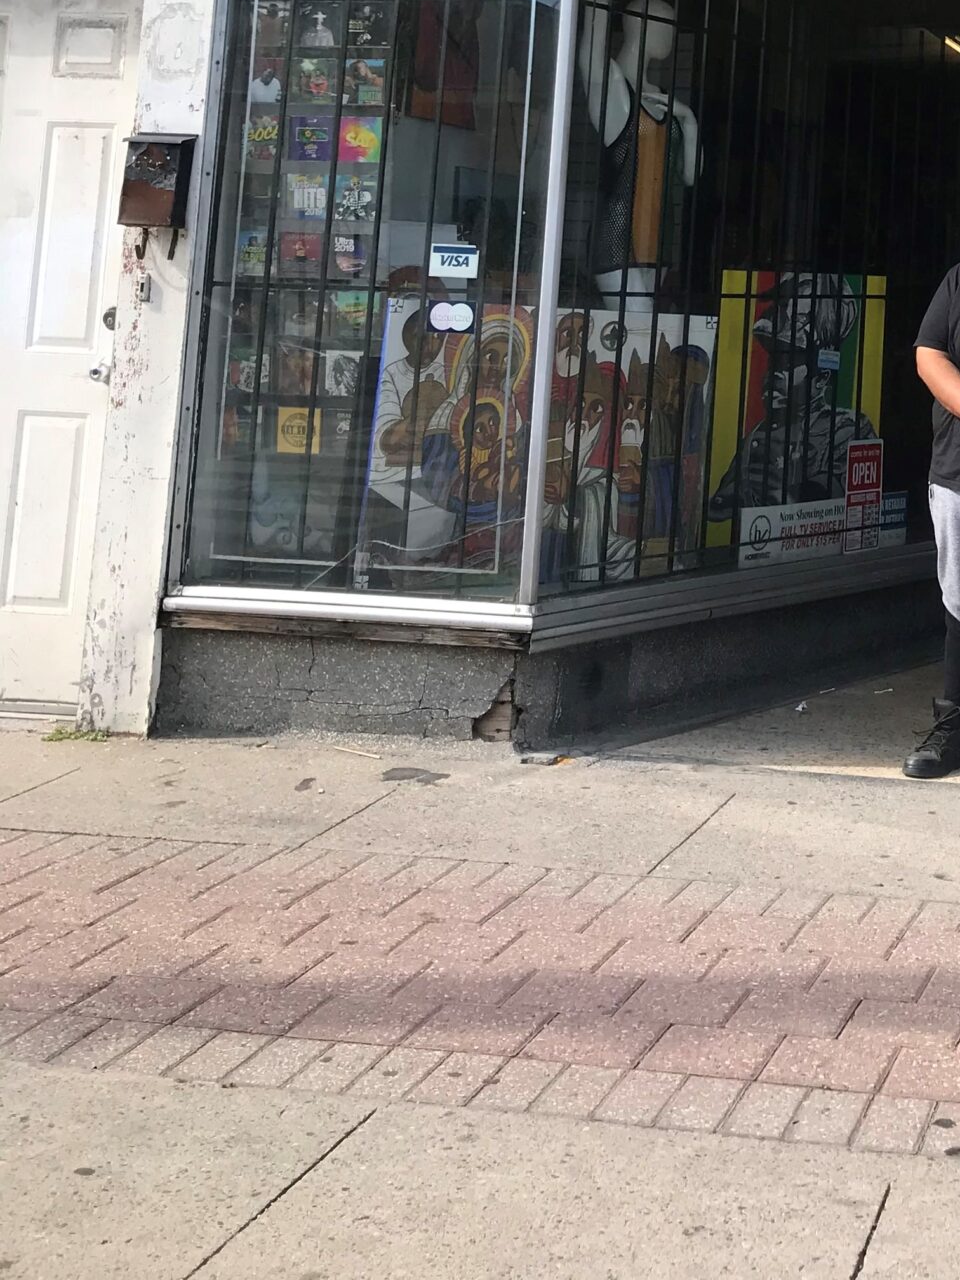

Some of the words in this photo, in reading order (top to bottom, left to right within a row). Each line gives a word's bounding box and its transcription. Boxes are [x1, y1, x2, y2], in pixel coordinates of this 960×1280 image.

[293, 187, 327, 209] HITS
[334, 245, 355, 253] 2019
[440, 254, 470, 268] VISA
[852, 461, 877, 485] OPEN
[780, 511, 794, 522] Now
[796, 507, 824, 520] Showing
[824, 507, 833, 516] on
[780, 525, 798, 538] FULL
[799, 523, 808, 535] TV
[808, 520, 837, 534] SERVICE
[780, 539, 795, 552] FOR
[796, 537, 813, 550] ONLY
